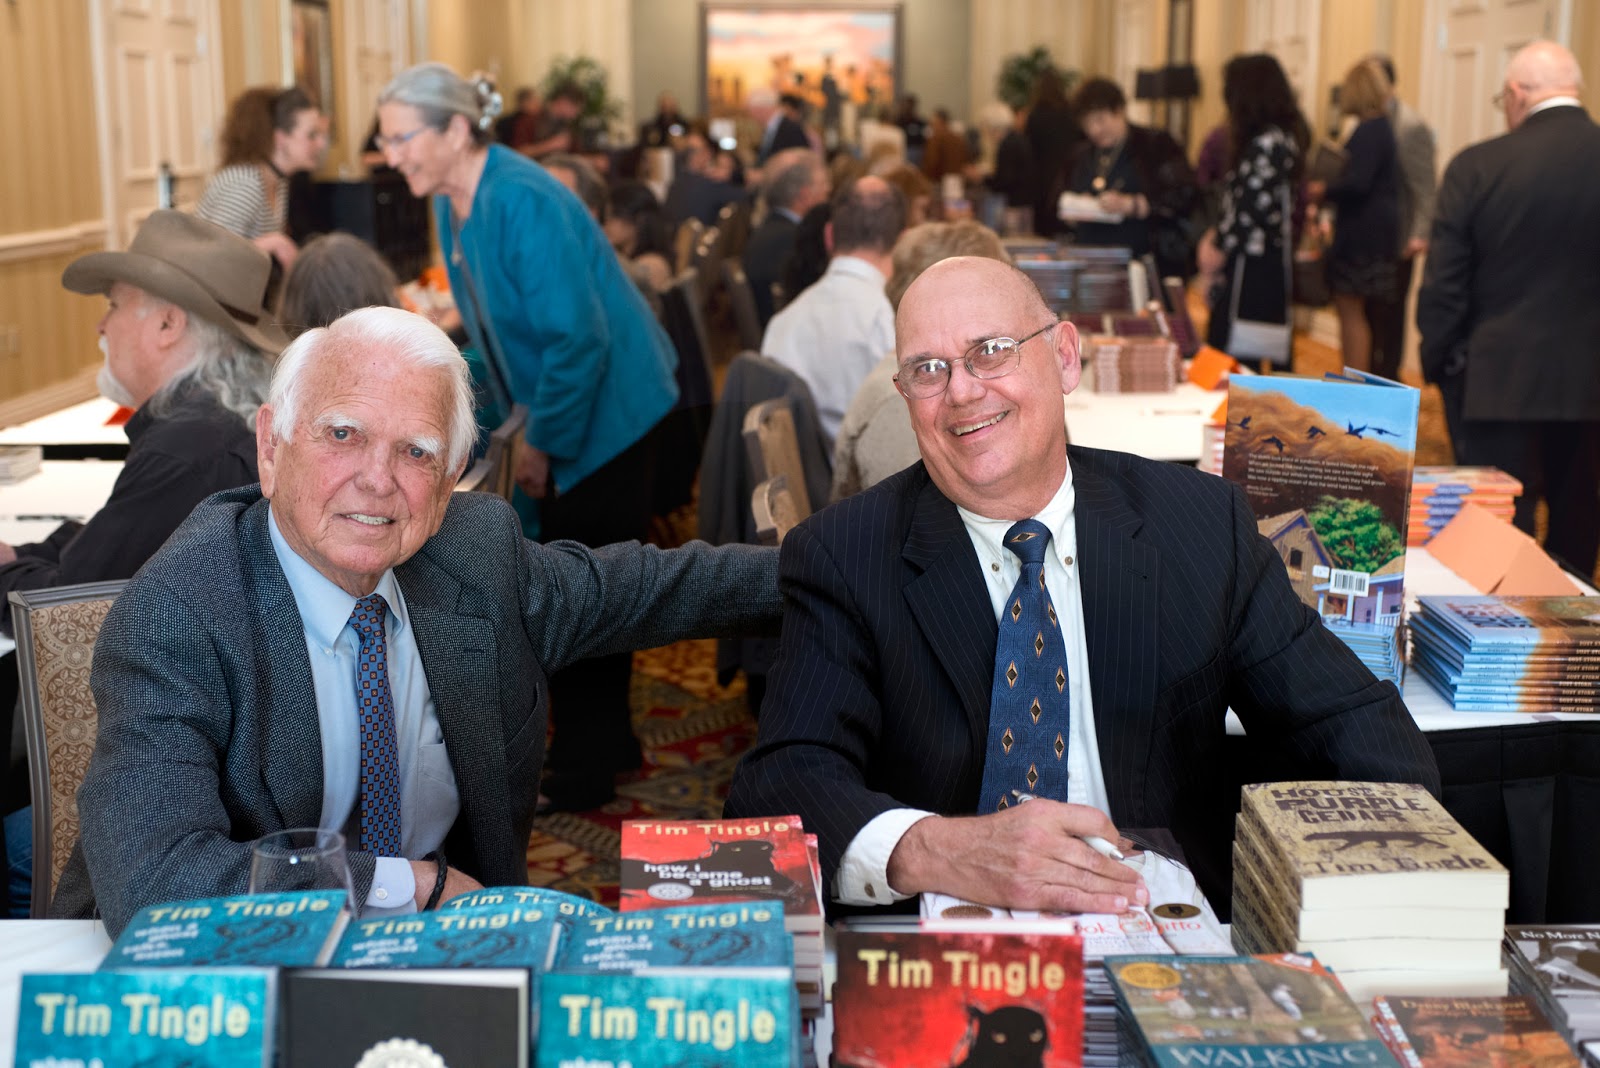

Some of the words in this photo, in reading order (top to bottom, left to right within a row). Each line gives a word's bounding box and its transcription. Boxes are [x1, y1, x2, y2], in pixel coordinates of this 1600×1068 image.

[1271, 787, 1377, 798] HOUSE
[1275, 797, 1429, 812] PURPLE
[1299, 809, 1409, 824] CEDAR
[632, 823, 689, 836] Tim
[697, 821, 790, 836] Tingle
[643, 863, 688, 873] how
[1303, 860, 1378, 874] Tim
[1383, 854, 1493, 873] Tingle
[659, 870, 743, 880] became
[689, 878, 702, 887] a
[708, 876, 772, 888] ghost
[149, 906, 212, 923] Tim
[223, 896, 331, 917] Tingle
[451, 893, 504, 911] Tim
[360, 919, 426, 937] Tim
[436, 907, 544, 931] Tingle
[589, 916, 654, 933] Tim
[664, 907, 772, 929] Tingle
[1520, 931, 1545, 939] No
[1545, 931, 1586, 940] More
[857, 949, 933, 989] Tim
[942, 950, 1066, 997] Tingle
[35, 993, 112, 1037] Tim
[122, 993, 251, 1045] Tingle
[559, 995, 638, 1041] Tim
[646, 996, 777, 1050] Tingle
[1169, 1045, 1379, 1068] WALKING
